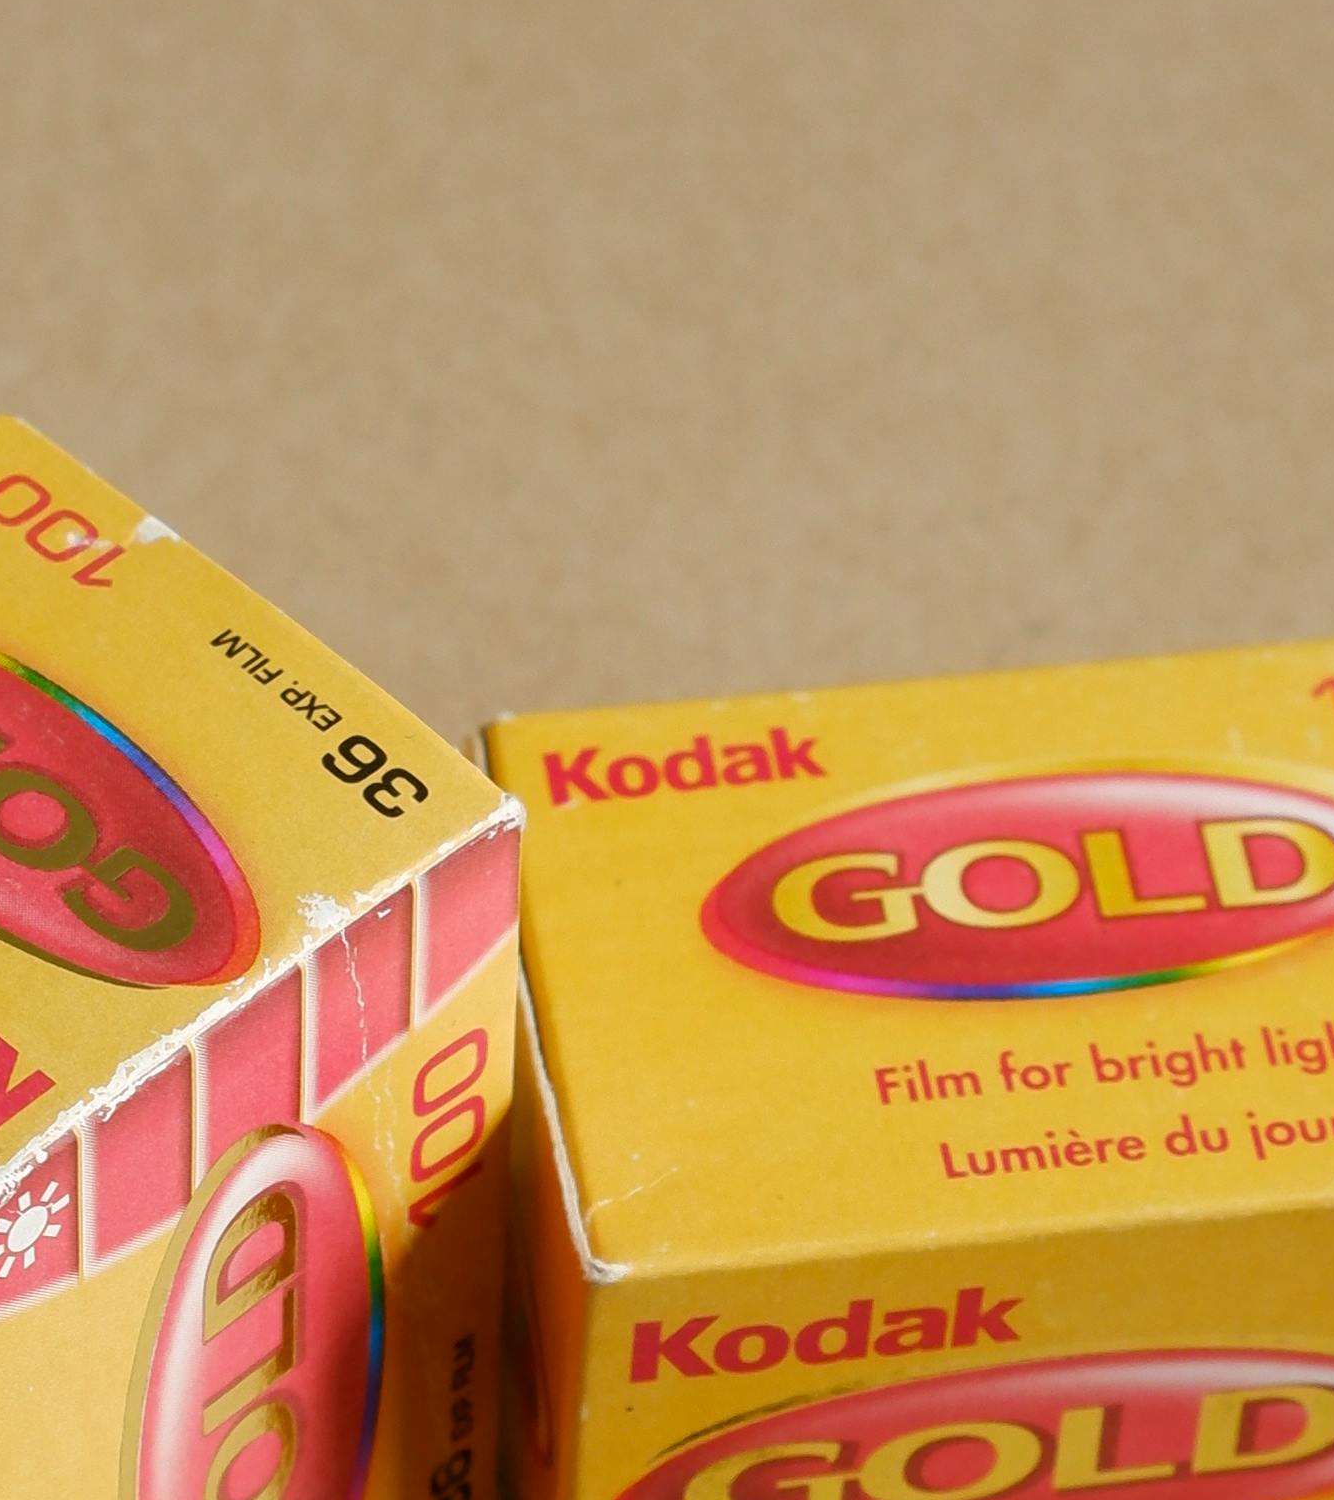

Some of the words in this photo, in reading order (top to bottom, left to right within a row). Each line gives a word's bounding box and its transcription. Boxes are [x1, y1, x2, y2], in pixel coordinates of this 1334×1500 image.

[210, 627, 284, 686] FILM
[279, 680, 343, 731] EXP.
[321, 735, 429, 818] 36
[543, 726, 826, 806] Kodak
[874, 1059, 983, 1106] Film
[998, 1049, 1073, 1093] for
[1088, 1031, 1247, 1088] bright
[408, 1028, 488, 1230] 100
[939, 1129, 1147, 1180] Lumière
[1164, 1113, 1230, 1157] du
[629, 1286, 1025, 1384] Kodak
